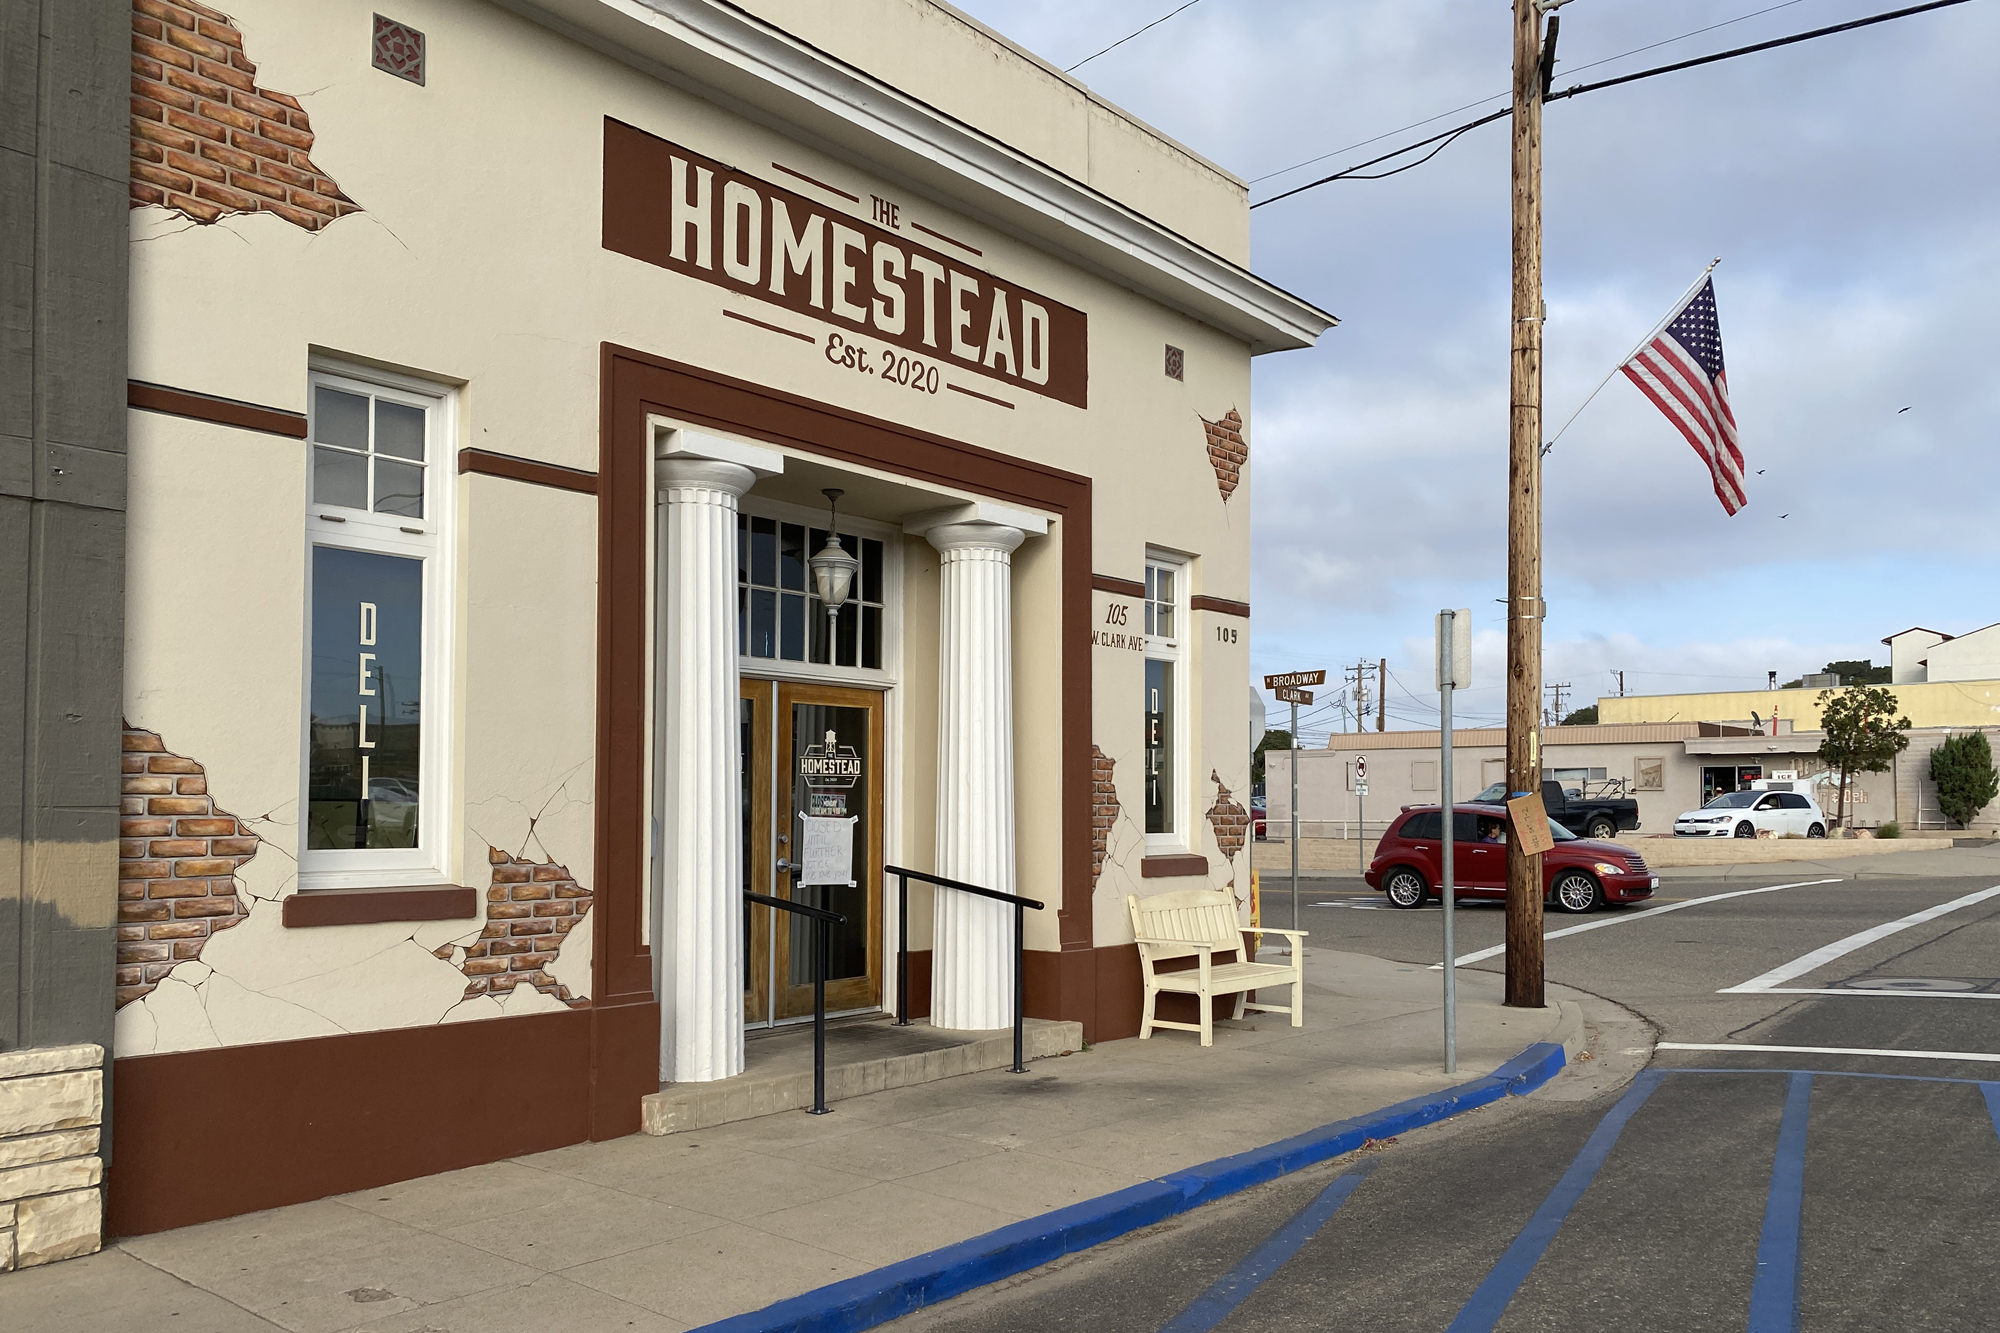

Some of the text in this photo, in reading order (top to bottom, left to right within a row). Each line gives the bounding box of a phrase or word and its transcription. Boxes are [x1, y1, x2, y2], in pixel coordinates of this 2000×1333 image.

[870, 193, 900, 229] THE
[669, 155, 1050, 387] HOMESTEAD
[825, 333, 940, 395] Est. 2020
[1105, 602, 1129, 626] 105
[1101, 632, 1127, 649] CLARK
[1127, 635, 1143, 652] AVE
[1216, 625, 1238, 644] 105
[1273, 672, 1319, 687] BROADWAY
[358, 602, 377, 800] DELI
[1282, 689, 1302, 702] CLARK
[1151, 688, 1159, 806] DELI
[801, 758, 860, 775] HOMESTEAD
[1843, 789, 1869, 804] Deli
[804, 845, 844, 859] FURTHER
